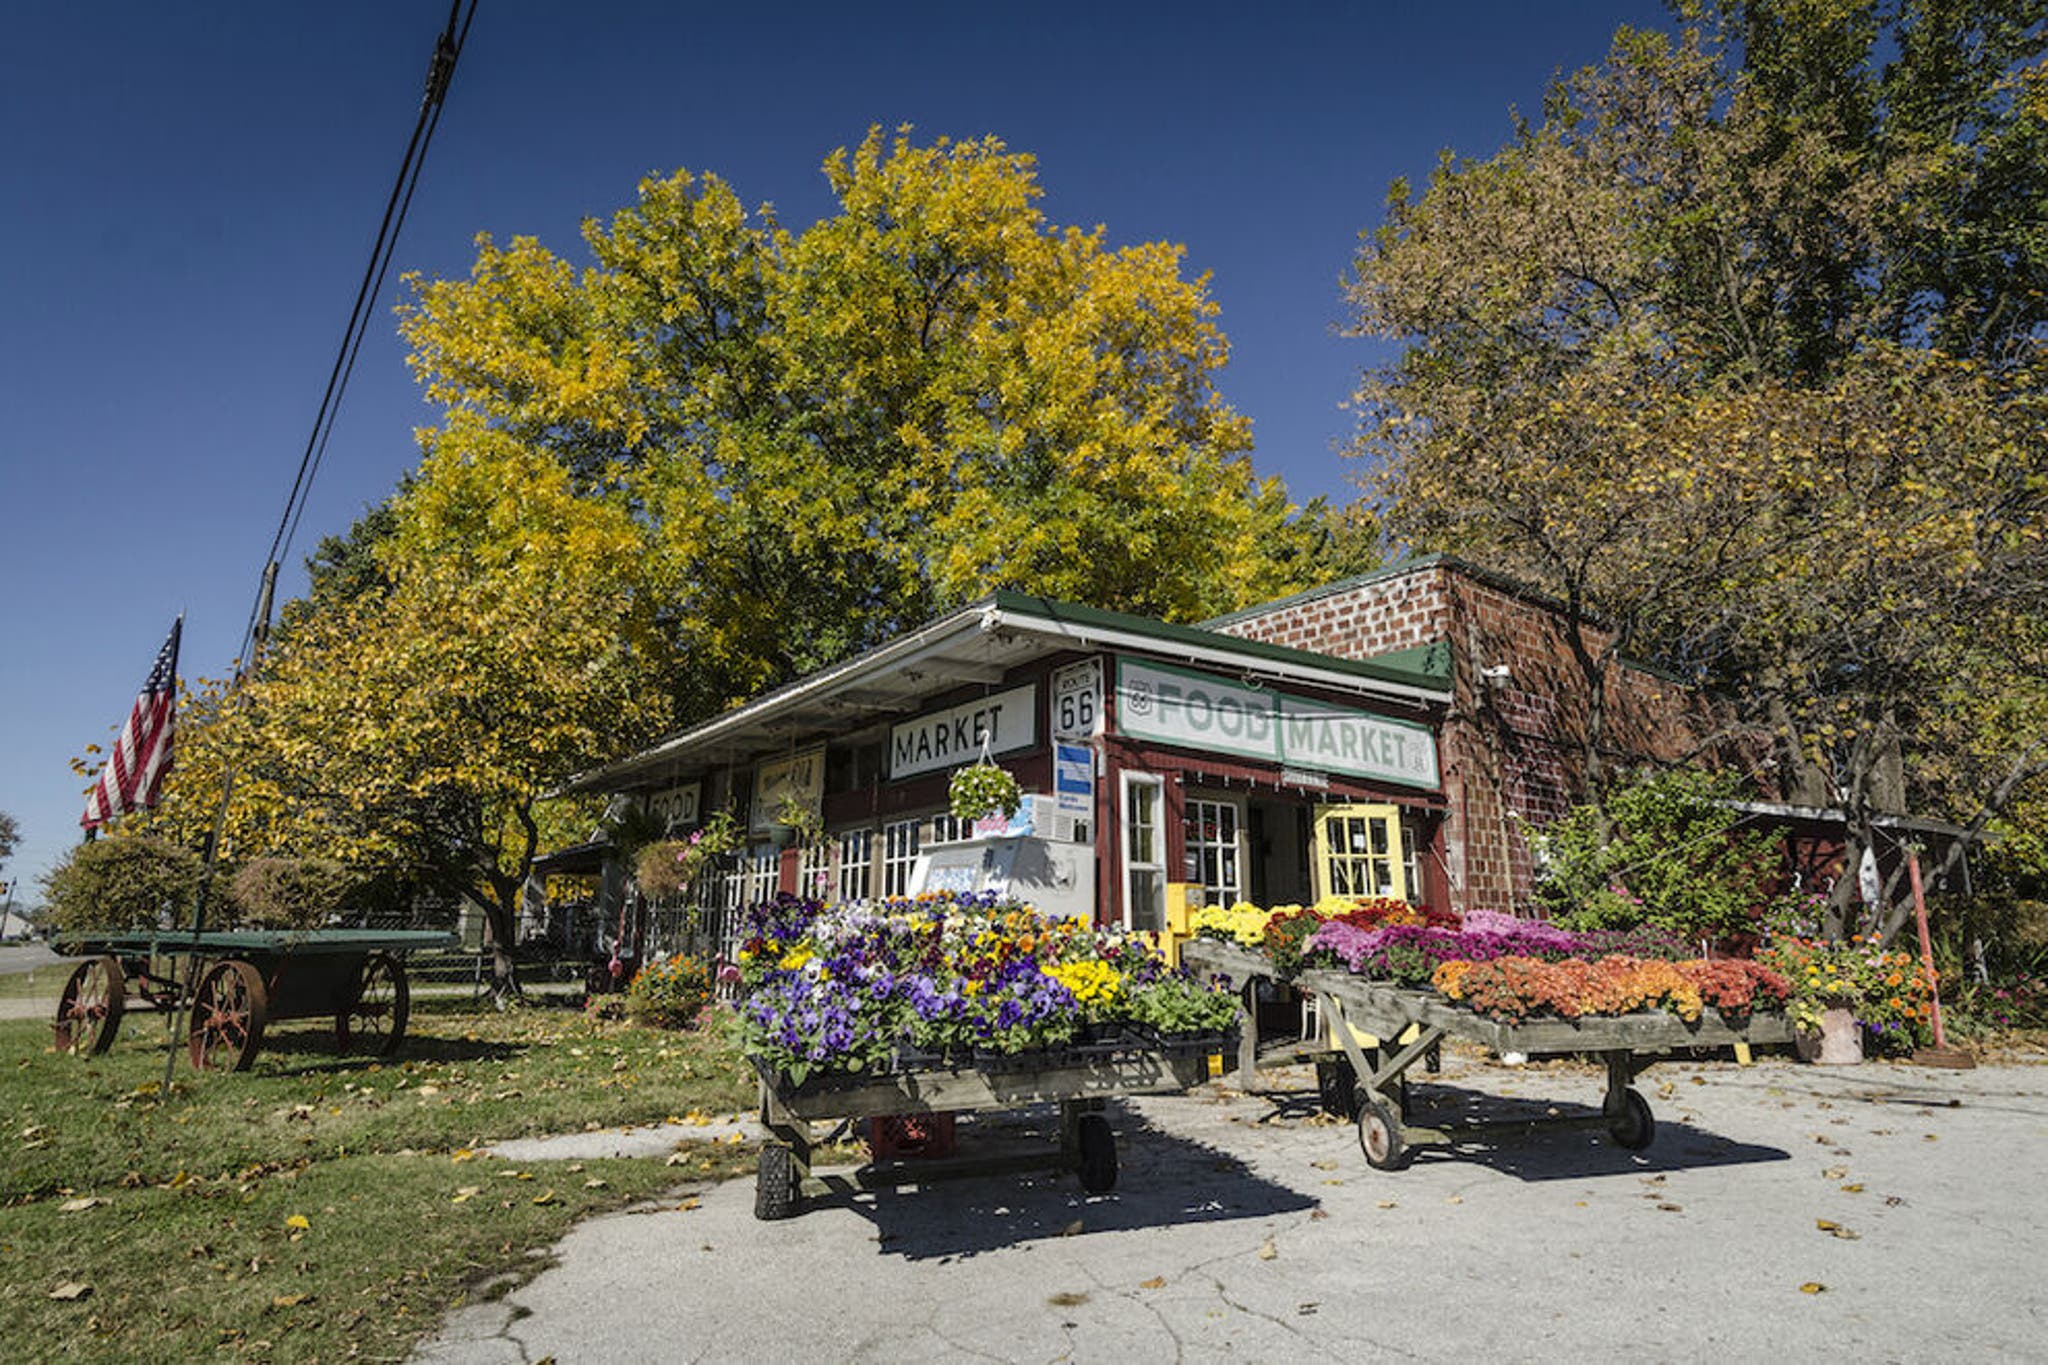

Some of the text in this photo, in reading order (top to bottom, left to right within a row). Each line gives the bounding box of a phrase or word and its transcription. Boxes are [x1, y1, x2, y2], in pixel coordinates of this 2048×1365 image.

[1063, 674, 1089, 689] ROUTE
[1061, 690, 1093, 730] 66
[1157, 683, 1269, 740] FOOD
[1289, 714, 1405, 769] MARKET
[894, 705, 1003, 769] MARKET
